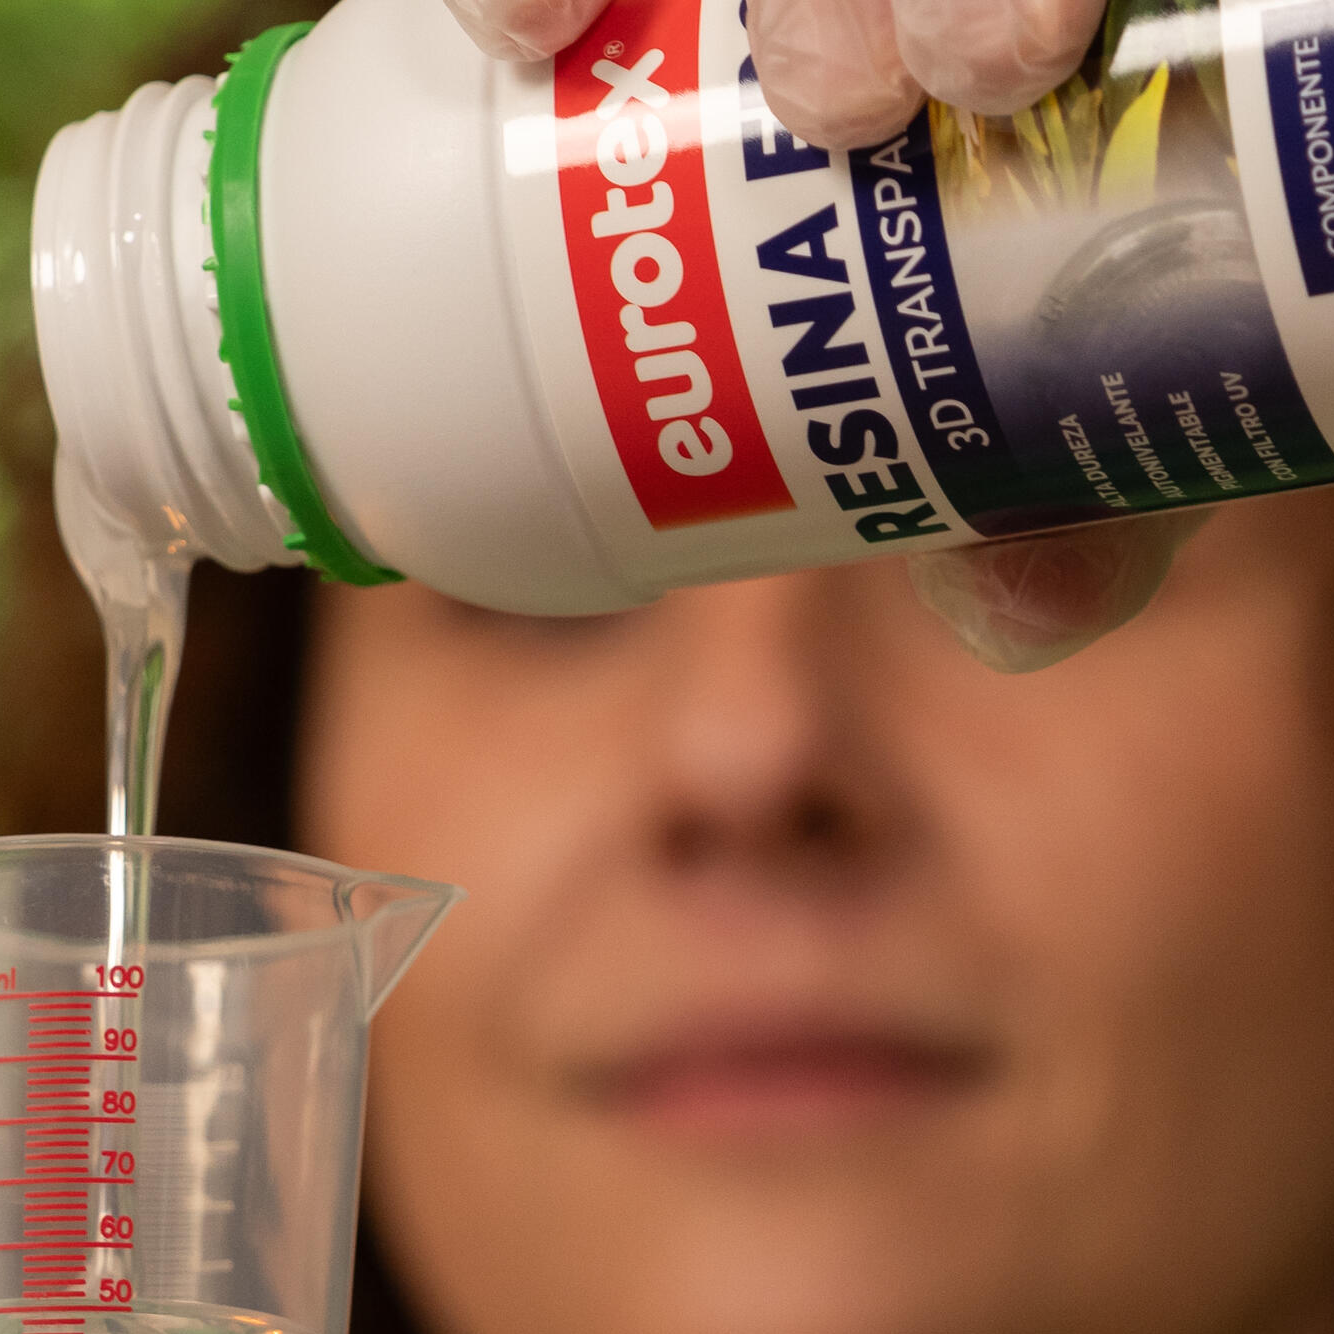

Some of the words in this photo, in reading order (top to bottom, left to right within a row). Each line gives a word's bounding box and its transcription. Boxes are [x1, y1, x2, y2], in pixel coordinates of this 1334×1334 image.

[870, 135, 957, 393] TRANSPA
[756, 202, 953, 544] RESINA
[1219, 371, 1250, 401] UV
[934, 398, 990, 452] 3D
[1100, 371, 1187, 499] AUTONIVELANTE
[1234, 402, 1281, 459] FILTRO
[1058, 412, 1109, 481] DUREZA
[1167, 390, 1244, 491] PIGMENTABLE
[1263, 458, 1299, 481] CON
[1094, 481, 1131, 508] ALTA
[95, 964, 145, 990] 100
[103, 1027, 138, 1052] 90
[101, 1090, 137, 1115] 80
[101, 1150, 135, 1176] 70
[99, 1214, 134, 1240] 60
[98, 1278, 133, 1303] 50
